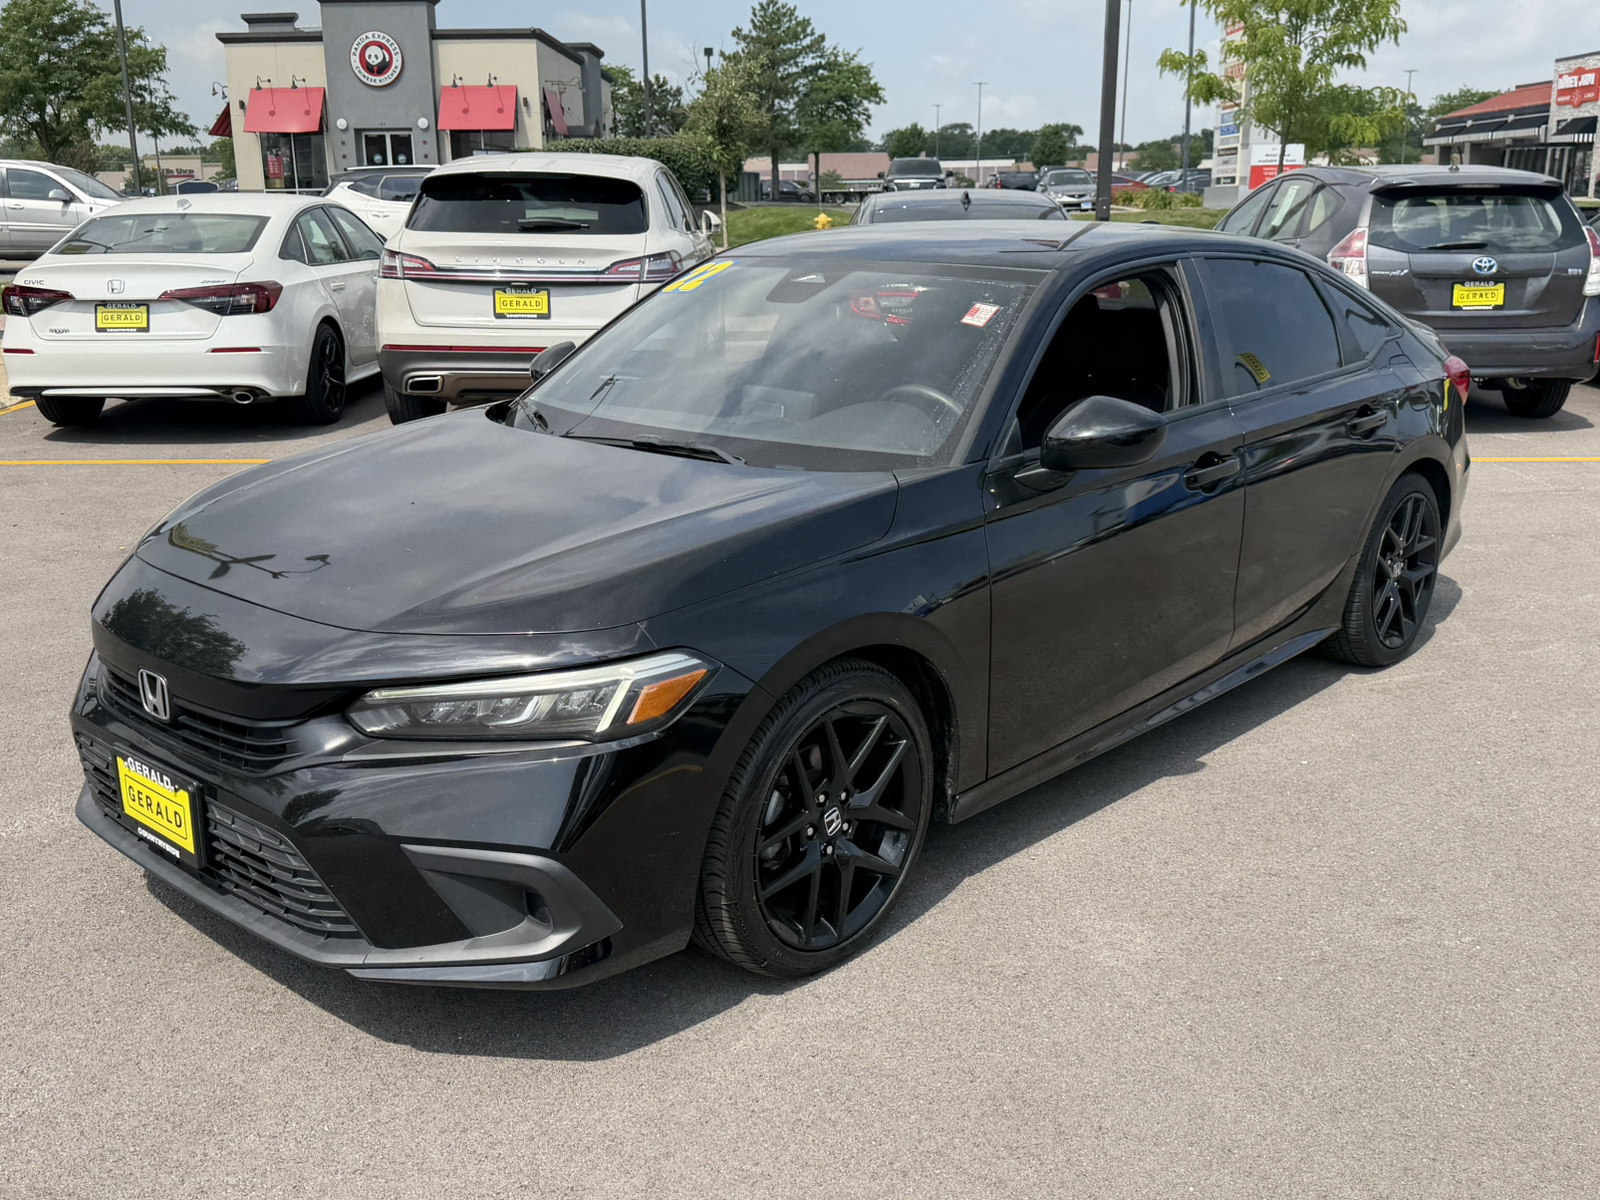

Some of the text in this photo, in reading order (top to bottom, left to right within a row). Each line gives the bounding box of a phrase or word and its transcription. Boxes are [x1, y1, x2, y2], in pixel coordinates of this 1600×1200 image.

[352, 33, 400, 57] PANDA EXPRESS
[355, 65, 399, 83] CHINESE KITCHEN
[455, 256, 586, 265] LINCOLN
[502, 299, 541, 308] GERALD
[1459, 291, 1497, 300] GERALD
[103, 313, 141, 322] GERALD
[127, 757, 171, 788] GERALD
[128, 785, 182, 828] GERALD
[137, 827, 180, 858] COUNTRYSIDE
